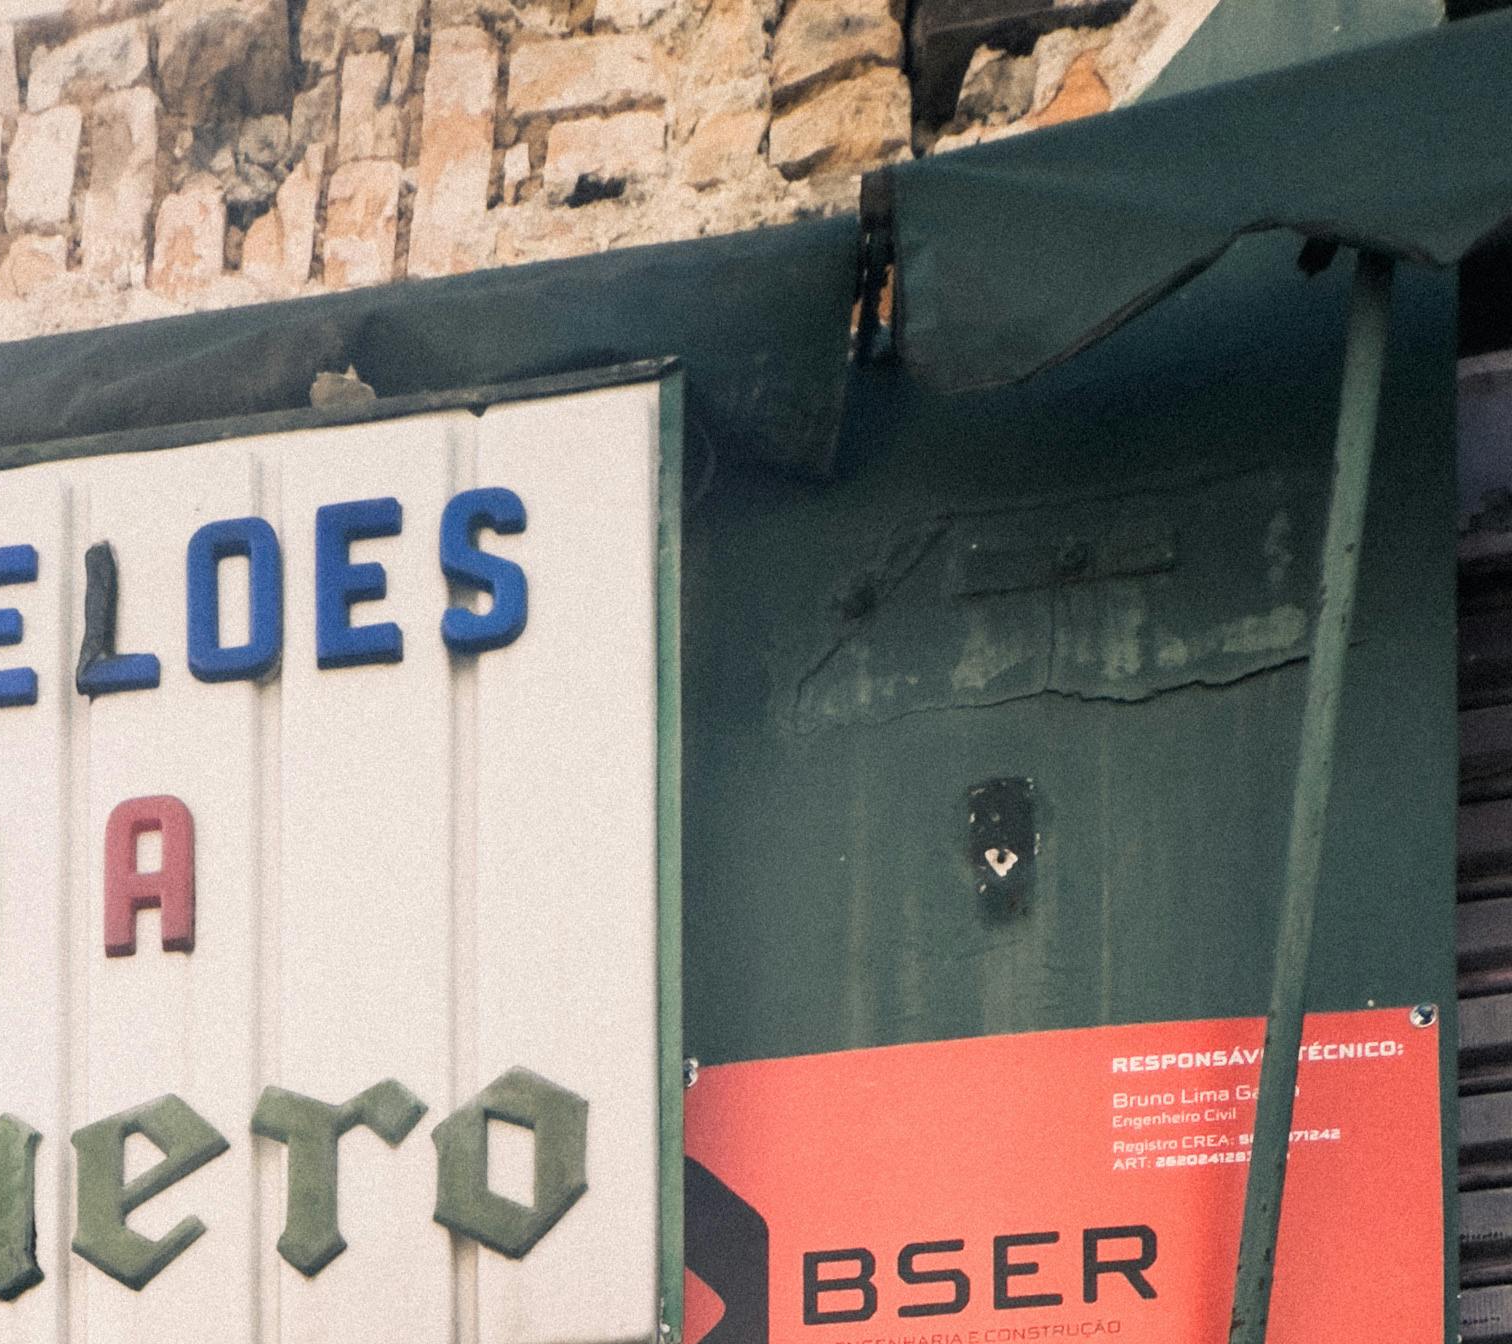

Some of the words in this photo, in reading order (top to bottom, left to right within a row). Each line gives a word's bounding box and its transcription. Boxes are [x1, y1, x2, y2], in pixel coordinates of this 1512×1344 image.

[1111, 1045, 1266, 1074] RESPONSÁV
[1112, 1091, 1175, 1109] Bruno
[1181, 1088, 1230, 1105] Lima
[1112, 1110, 1201, 1129] Engenheiro
[1204, 1107, 1237, 1122] Civil
[1112, 1138, 1178, 1155] Registro
[1181, 1134, 1235, 1149] CREA:
[1112, 1156, 1152, 1171] ART:
[802, 1223, 1159, 1326] BSER
[968, 1330, 980, 1344] E
[984, 1318, 1122, 1344] CONSTRUÇÃO
